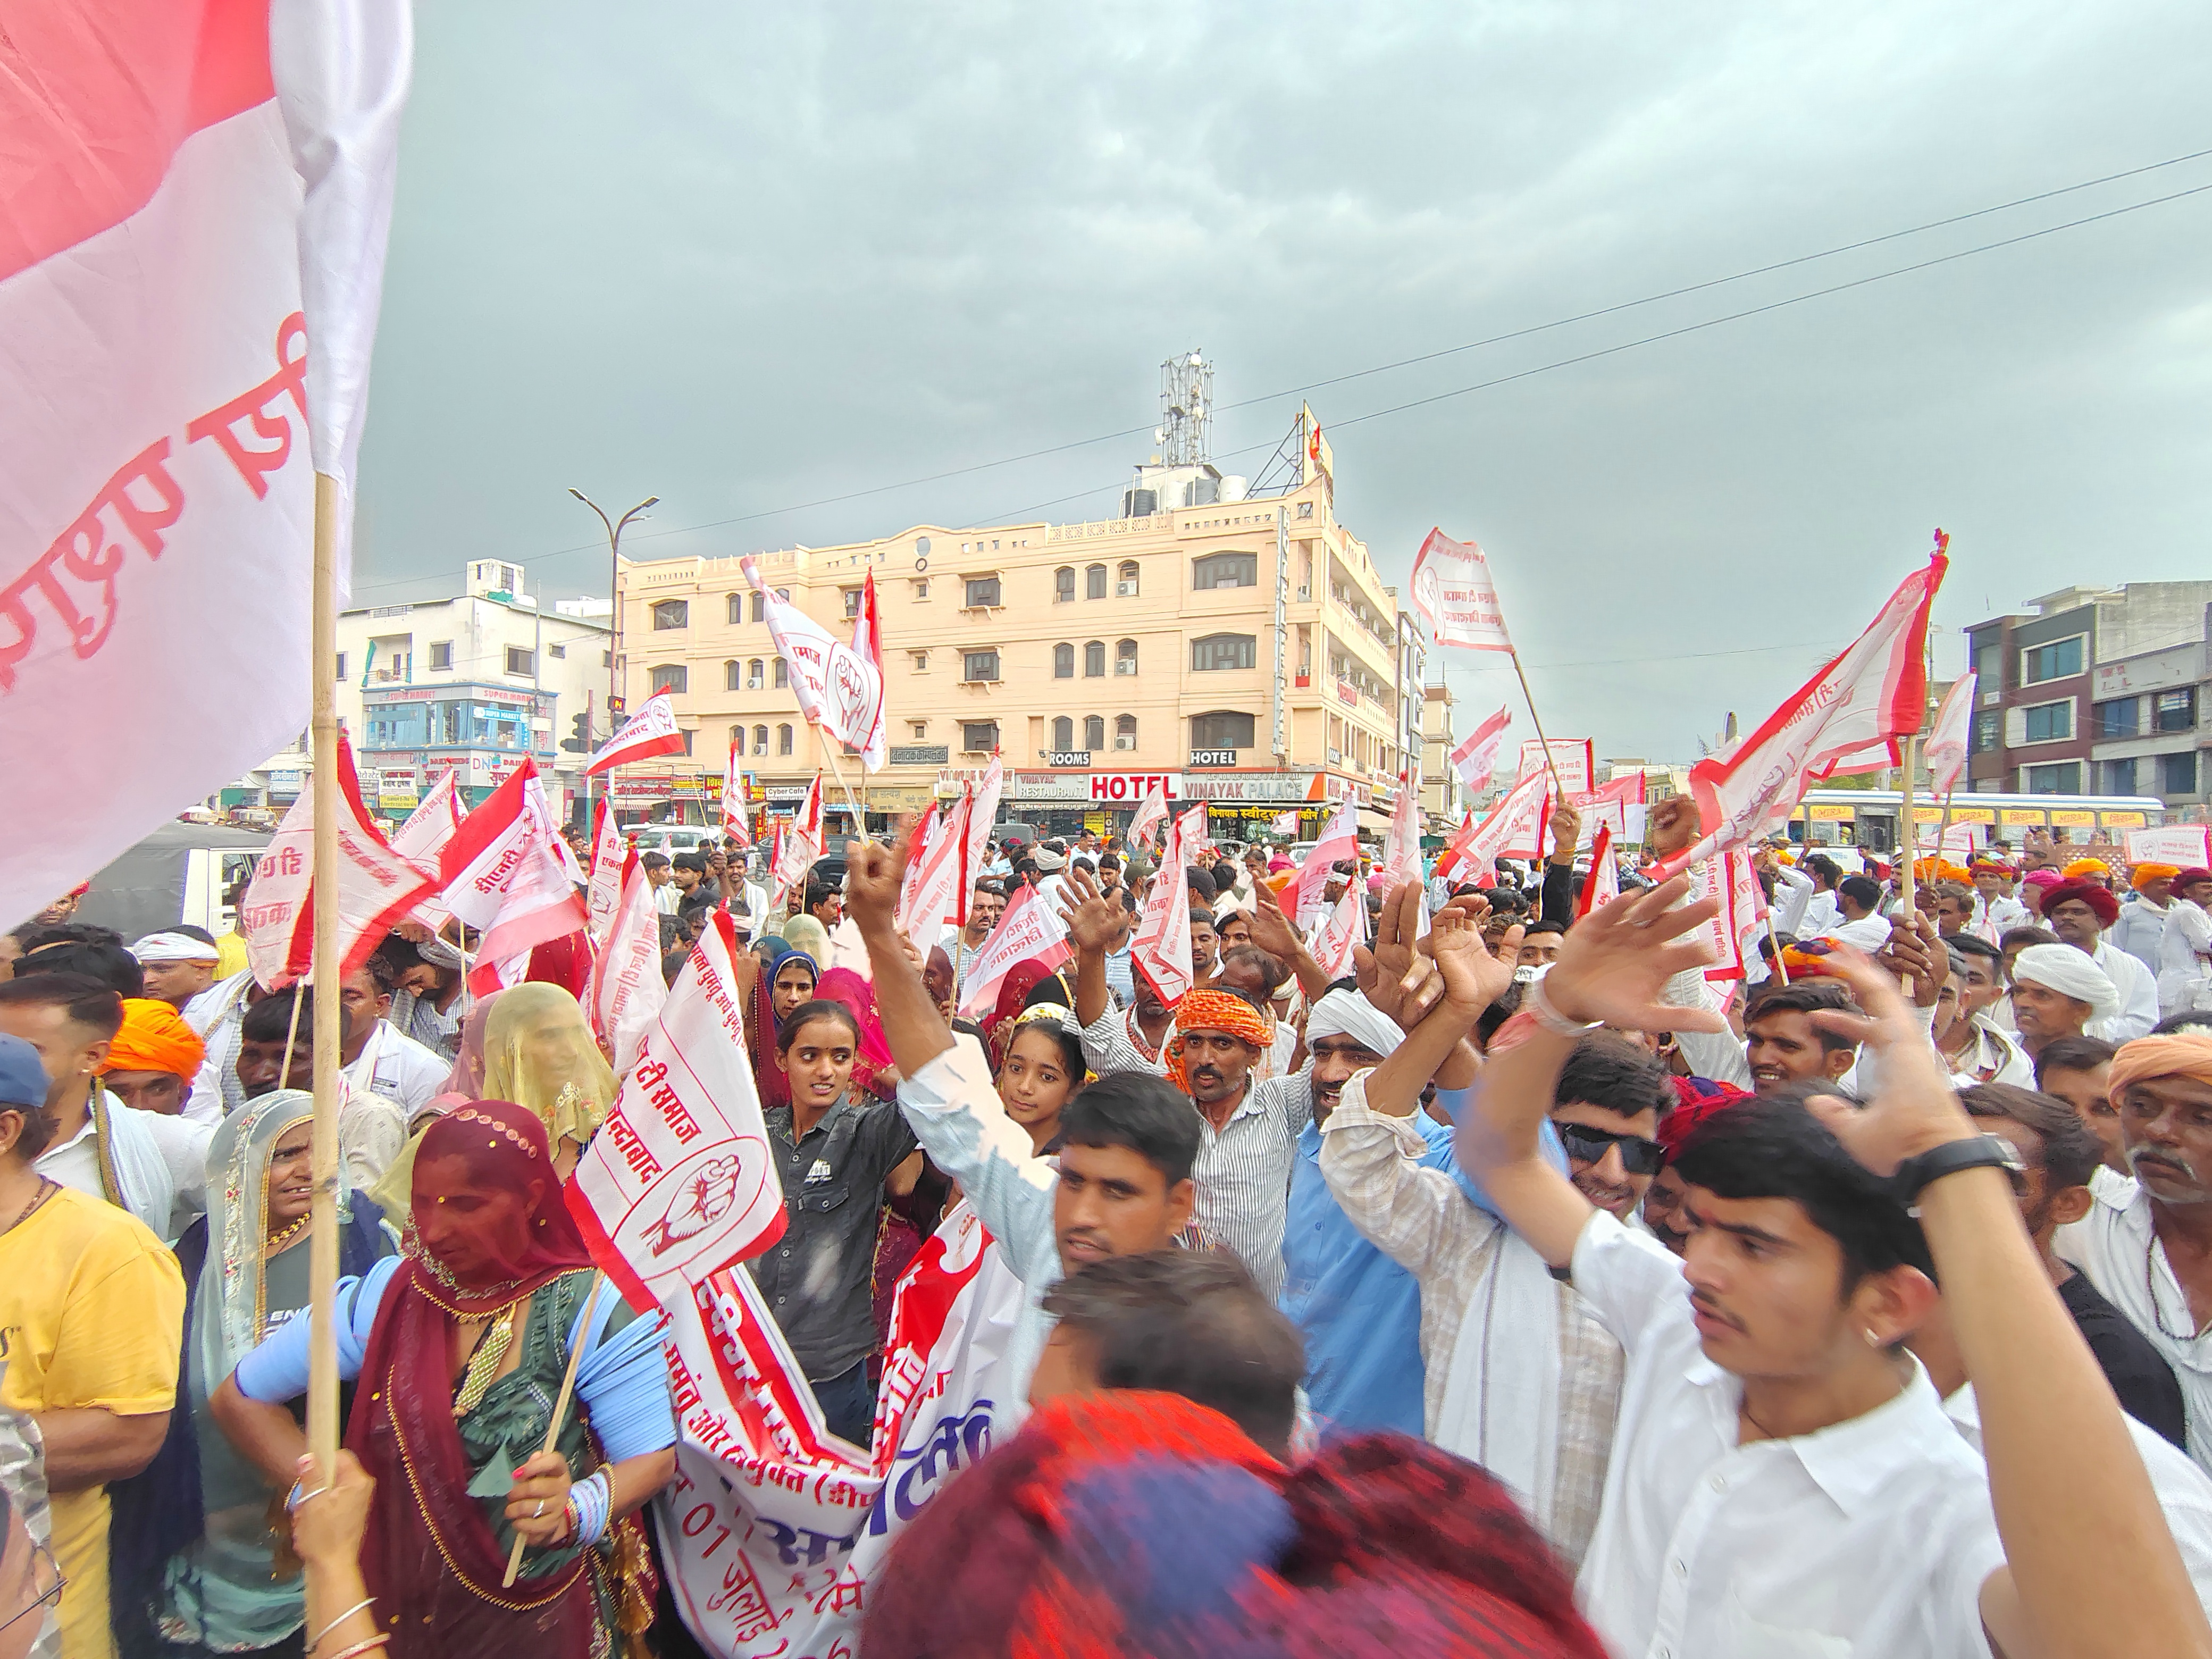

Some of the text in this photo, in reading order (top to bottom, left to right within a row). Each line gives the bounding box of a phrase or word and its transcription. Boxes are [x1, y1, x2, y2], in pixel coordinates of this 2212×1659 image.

[484, 690, 508, 700] SUPER
[473, 757, 491, 770] DN
[1050, 752, 1090, 765] ROOMS
[1191, 752, 1235, 764] HOTEL
[1020, 775, 1057, 784] VINAYAK
[1092, 775, 1177, 800] HOTEL
[768, 788, 788, 797] Cyber
[1020, 786, 1085, 798] RESTAURANT
[1185, 781, 1303, 799] VINAYAK PALACE
[1208, 805, 1238, 818] विनायक
[1239, 806, 1280, 821] स्वीट्स
[475, 849, 519, 895] डीएनटी
[601, 856, 623, 871] एकत
[686, 941, 711, 973] मुक्त
[697, 967, 723, 1002] घुमंतू
[714, 992, 735, 1015] अर्ध
[636, 1059, 702, 1146] टी समाज
[689, 1408, 733, 1452] और
[682, 1502, 732, 1560] 01
[707, 1548, 794, 1652] जुलाई
